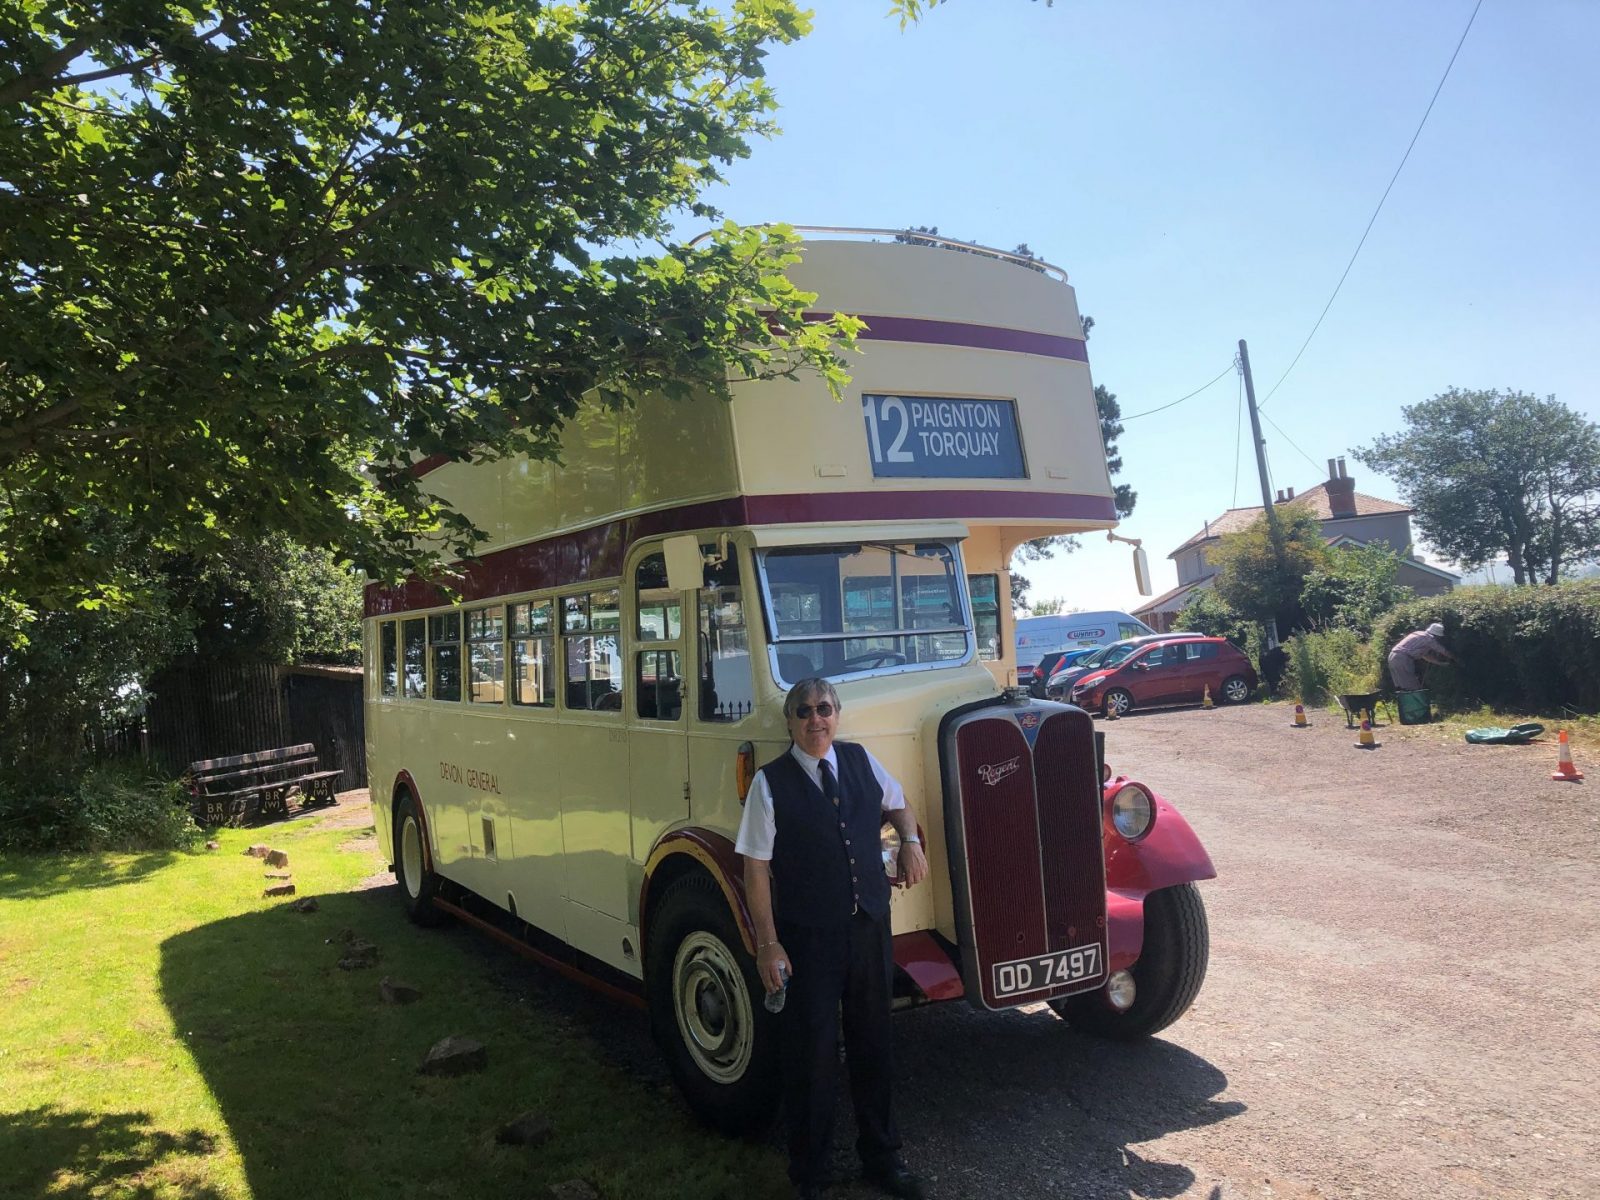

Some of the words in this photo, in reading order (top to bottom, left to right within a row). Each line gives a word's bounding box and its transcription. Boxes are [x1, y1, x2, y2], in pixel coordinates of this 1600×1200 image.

[863, 396, 914, 463] 12
[911, 402, 1001, 428] PAIGNTON
[918, 432, 999, 459] TORQUAY
[440, 761, 463, 784] DEVON
[466, 769, 501, 794] GENERAL
[978, 757, 1020, 785] Regent
[1000, 963, 1032, 992] OD
[1040, 948, 1097, 984] 7497
